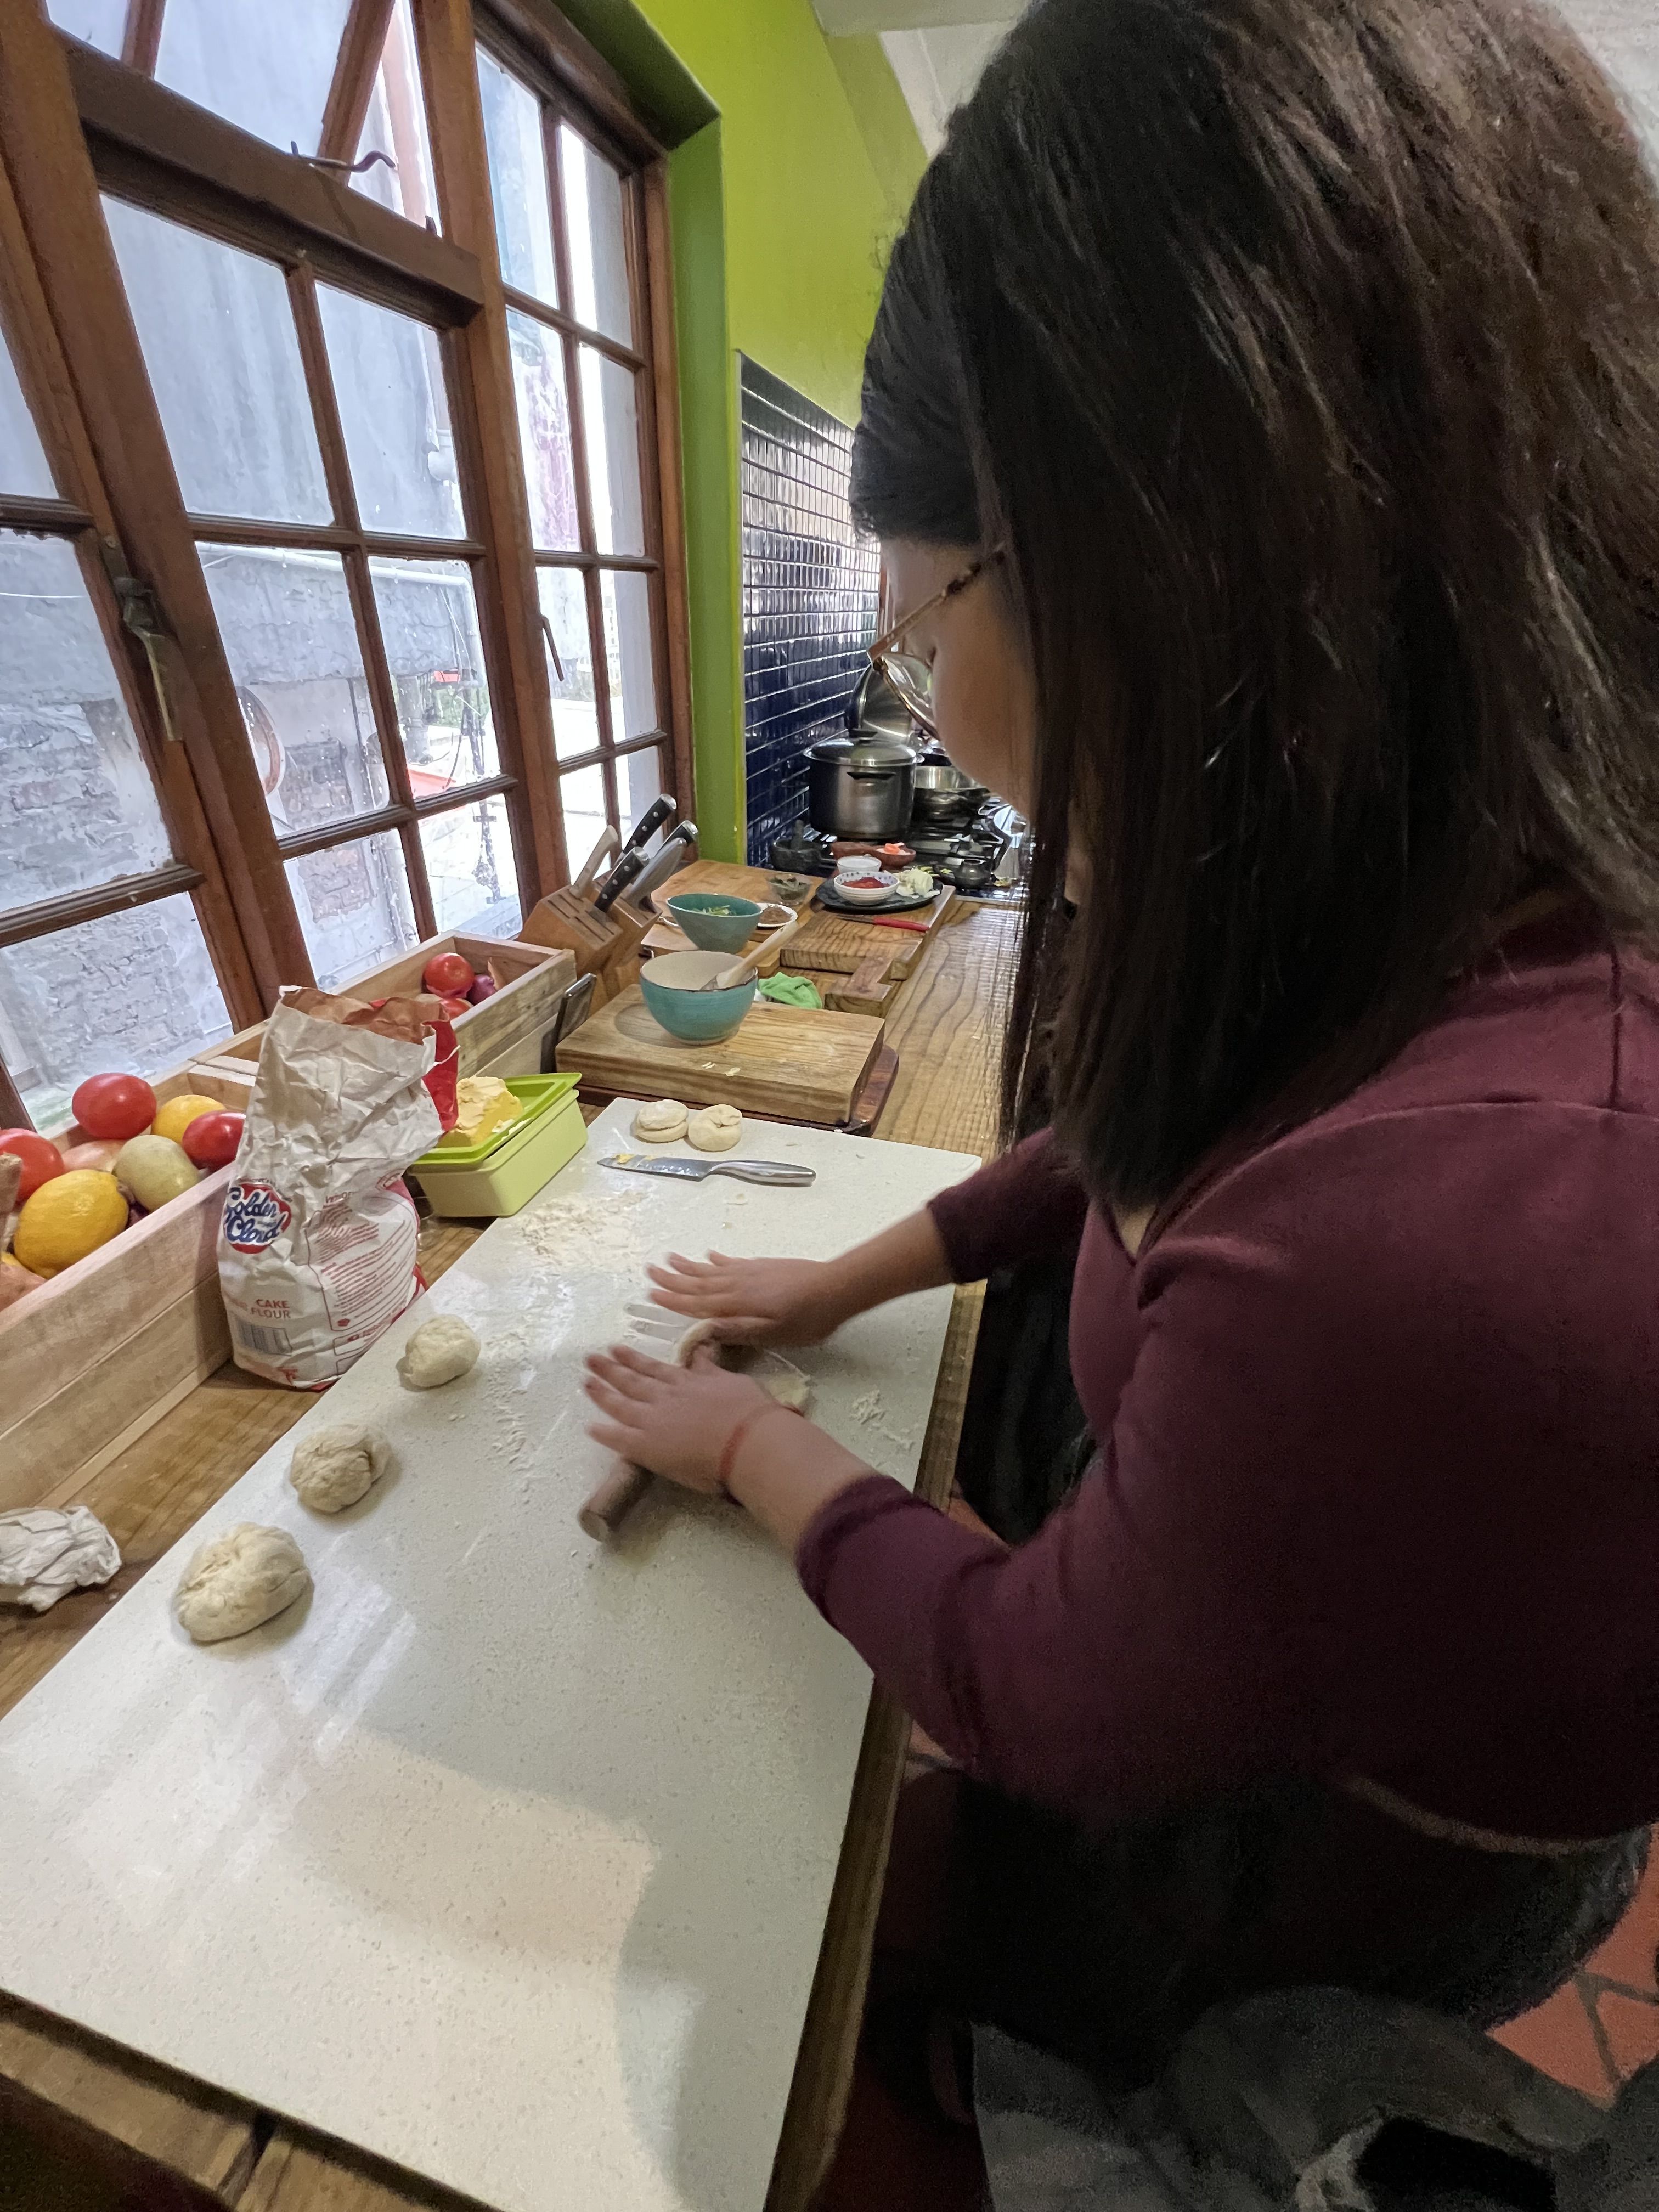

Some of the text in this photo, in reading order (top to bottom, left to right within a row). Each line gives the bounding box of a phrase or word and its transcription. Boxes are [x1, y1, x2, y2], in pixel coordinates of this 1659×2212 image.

[227, 1214, 286, 1243] Cloud
[256, 1299, 290, 1309] CAKE
[251, 1307, 291, 1319] FLOUR
